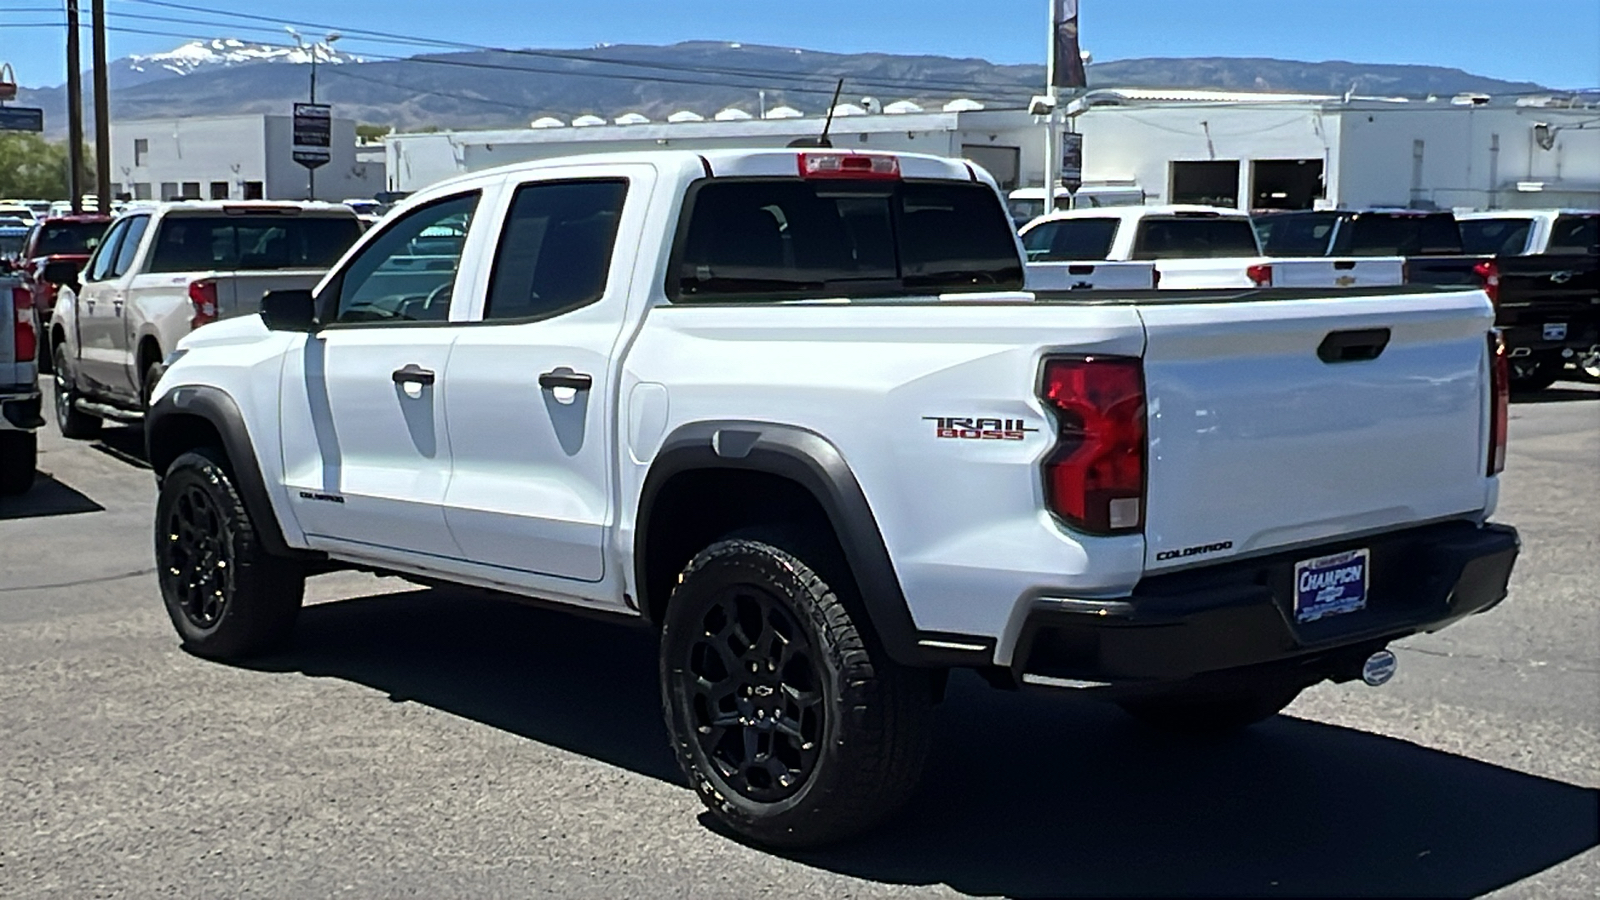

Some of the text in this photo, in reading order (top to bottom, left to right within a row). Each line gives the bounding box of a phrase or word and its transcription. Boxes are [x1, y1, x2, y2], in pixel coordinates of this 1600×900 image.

[921, 416, 1039, 432] TRAIL
[937, 428, 1024, 440] BOSS
[1156, 541, 1233, 561] COLORADO
[1299, 564, 1363, 593] CHAMPION
